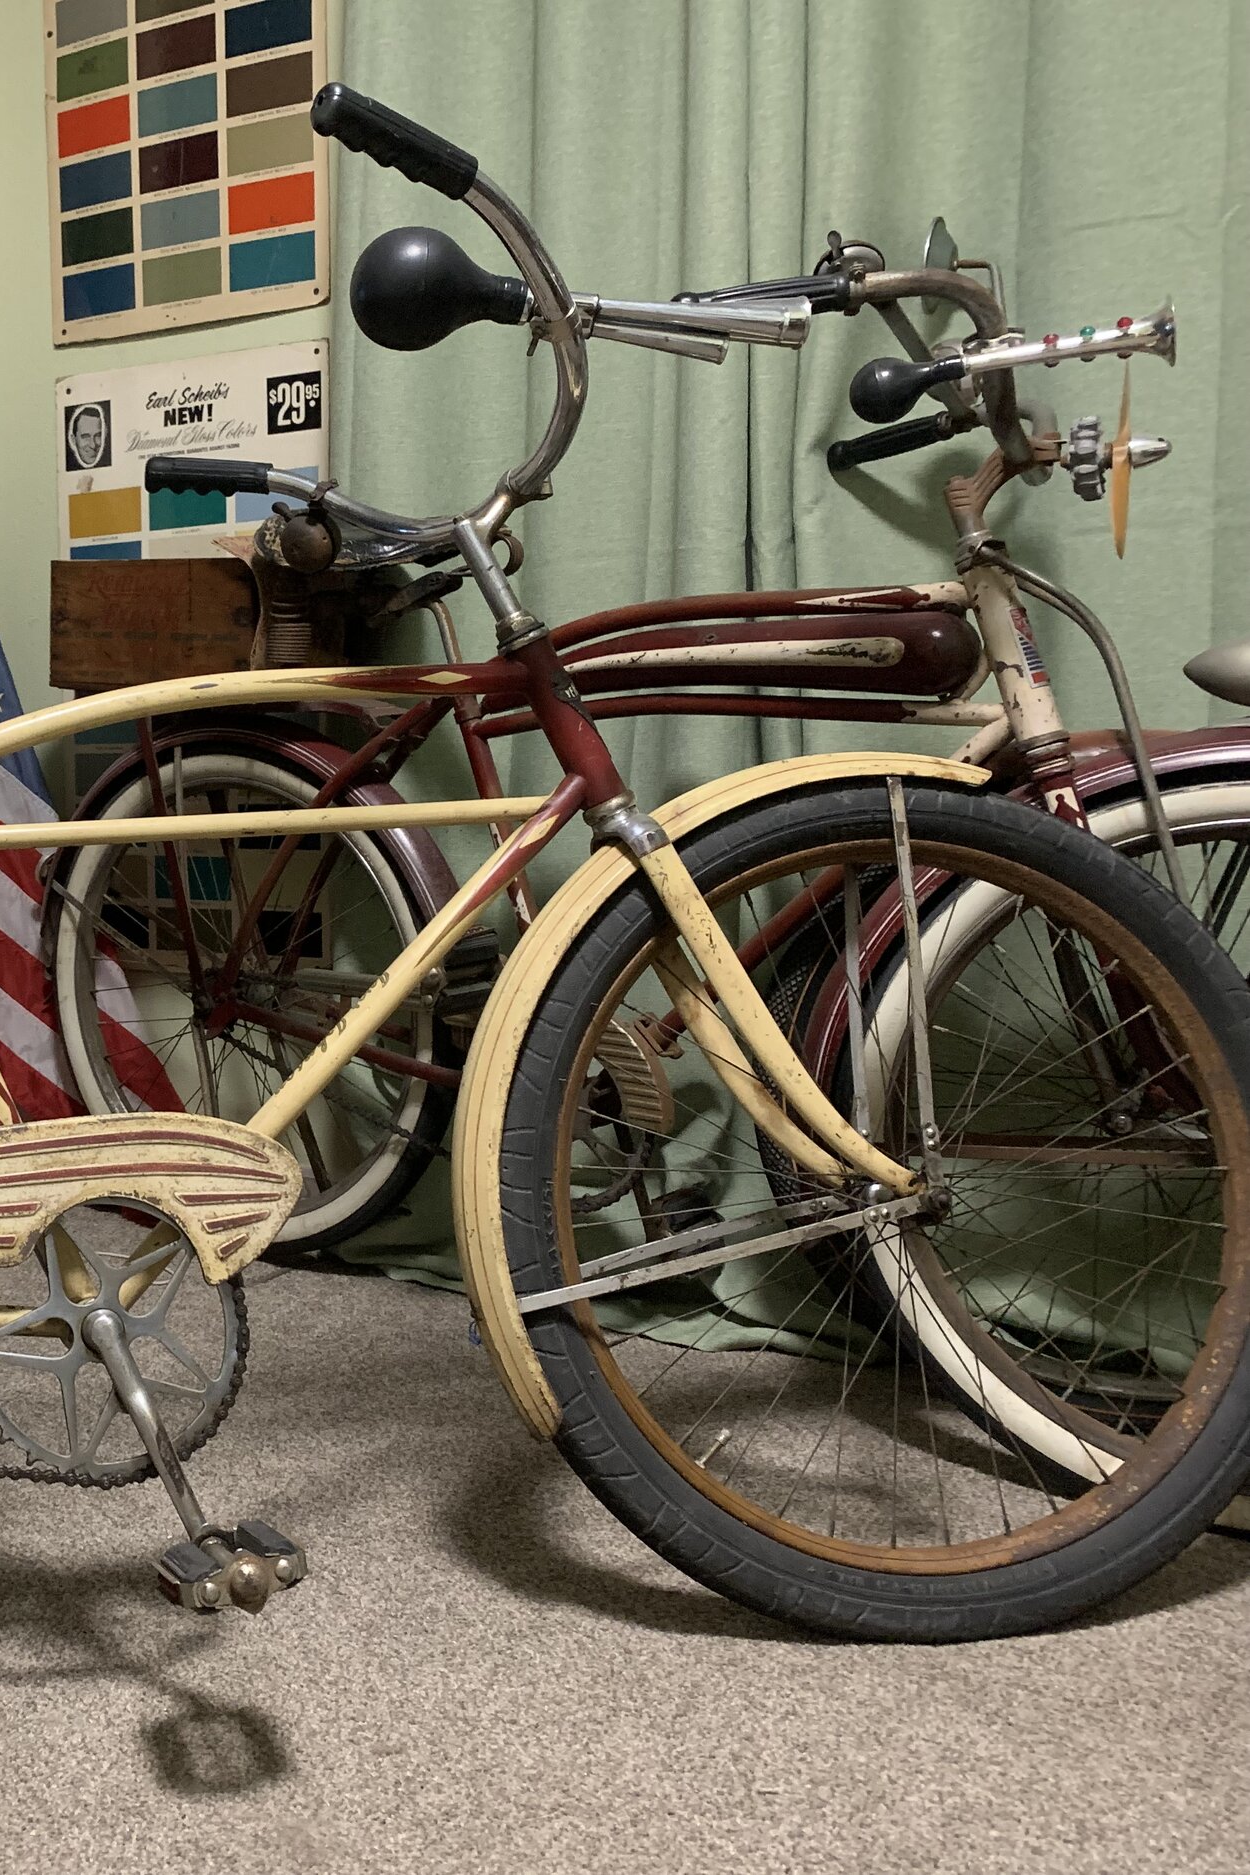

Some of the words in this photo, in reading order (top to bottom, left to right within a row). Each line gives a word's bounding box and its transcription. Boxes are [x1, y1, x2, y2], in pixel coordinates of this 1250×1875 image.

[145, 389, 177, 410] Earl
[178, 382, 230, 405] Scheib's
[163, 403, 213, 427] NEW!
[125, 429, 182, 453] Diamond
[181, 424, 216, 446] Gloss
[216, 418, 258, 440] Colors
